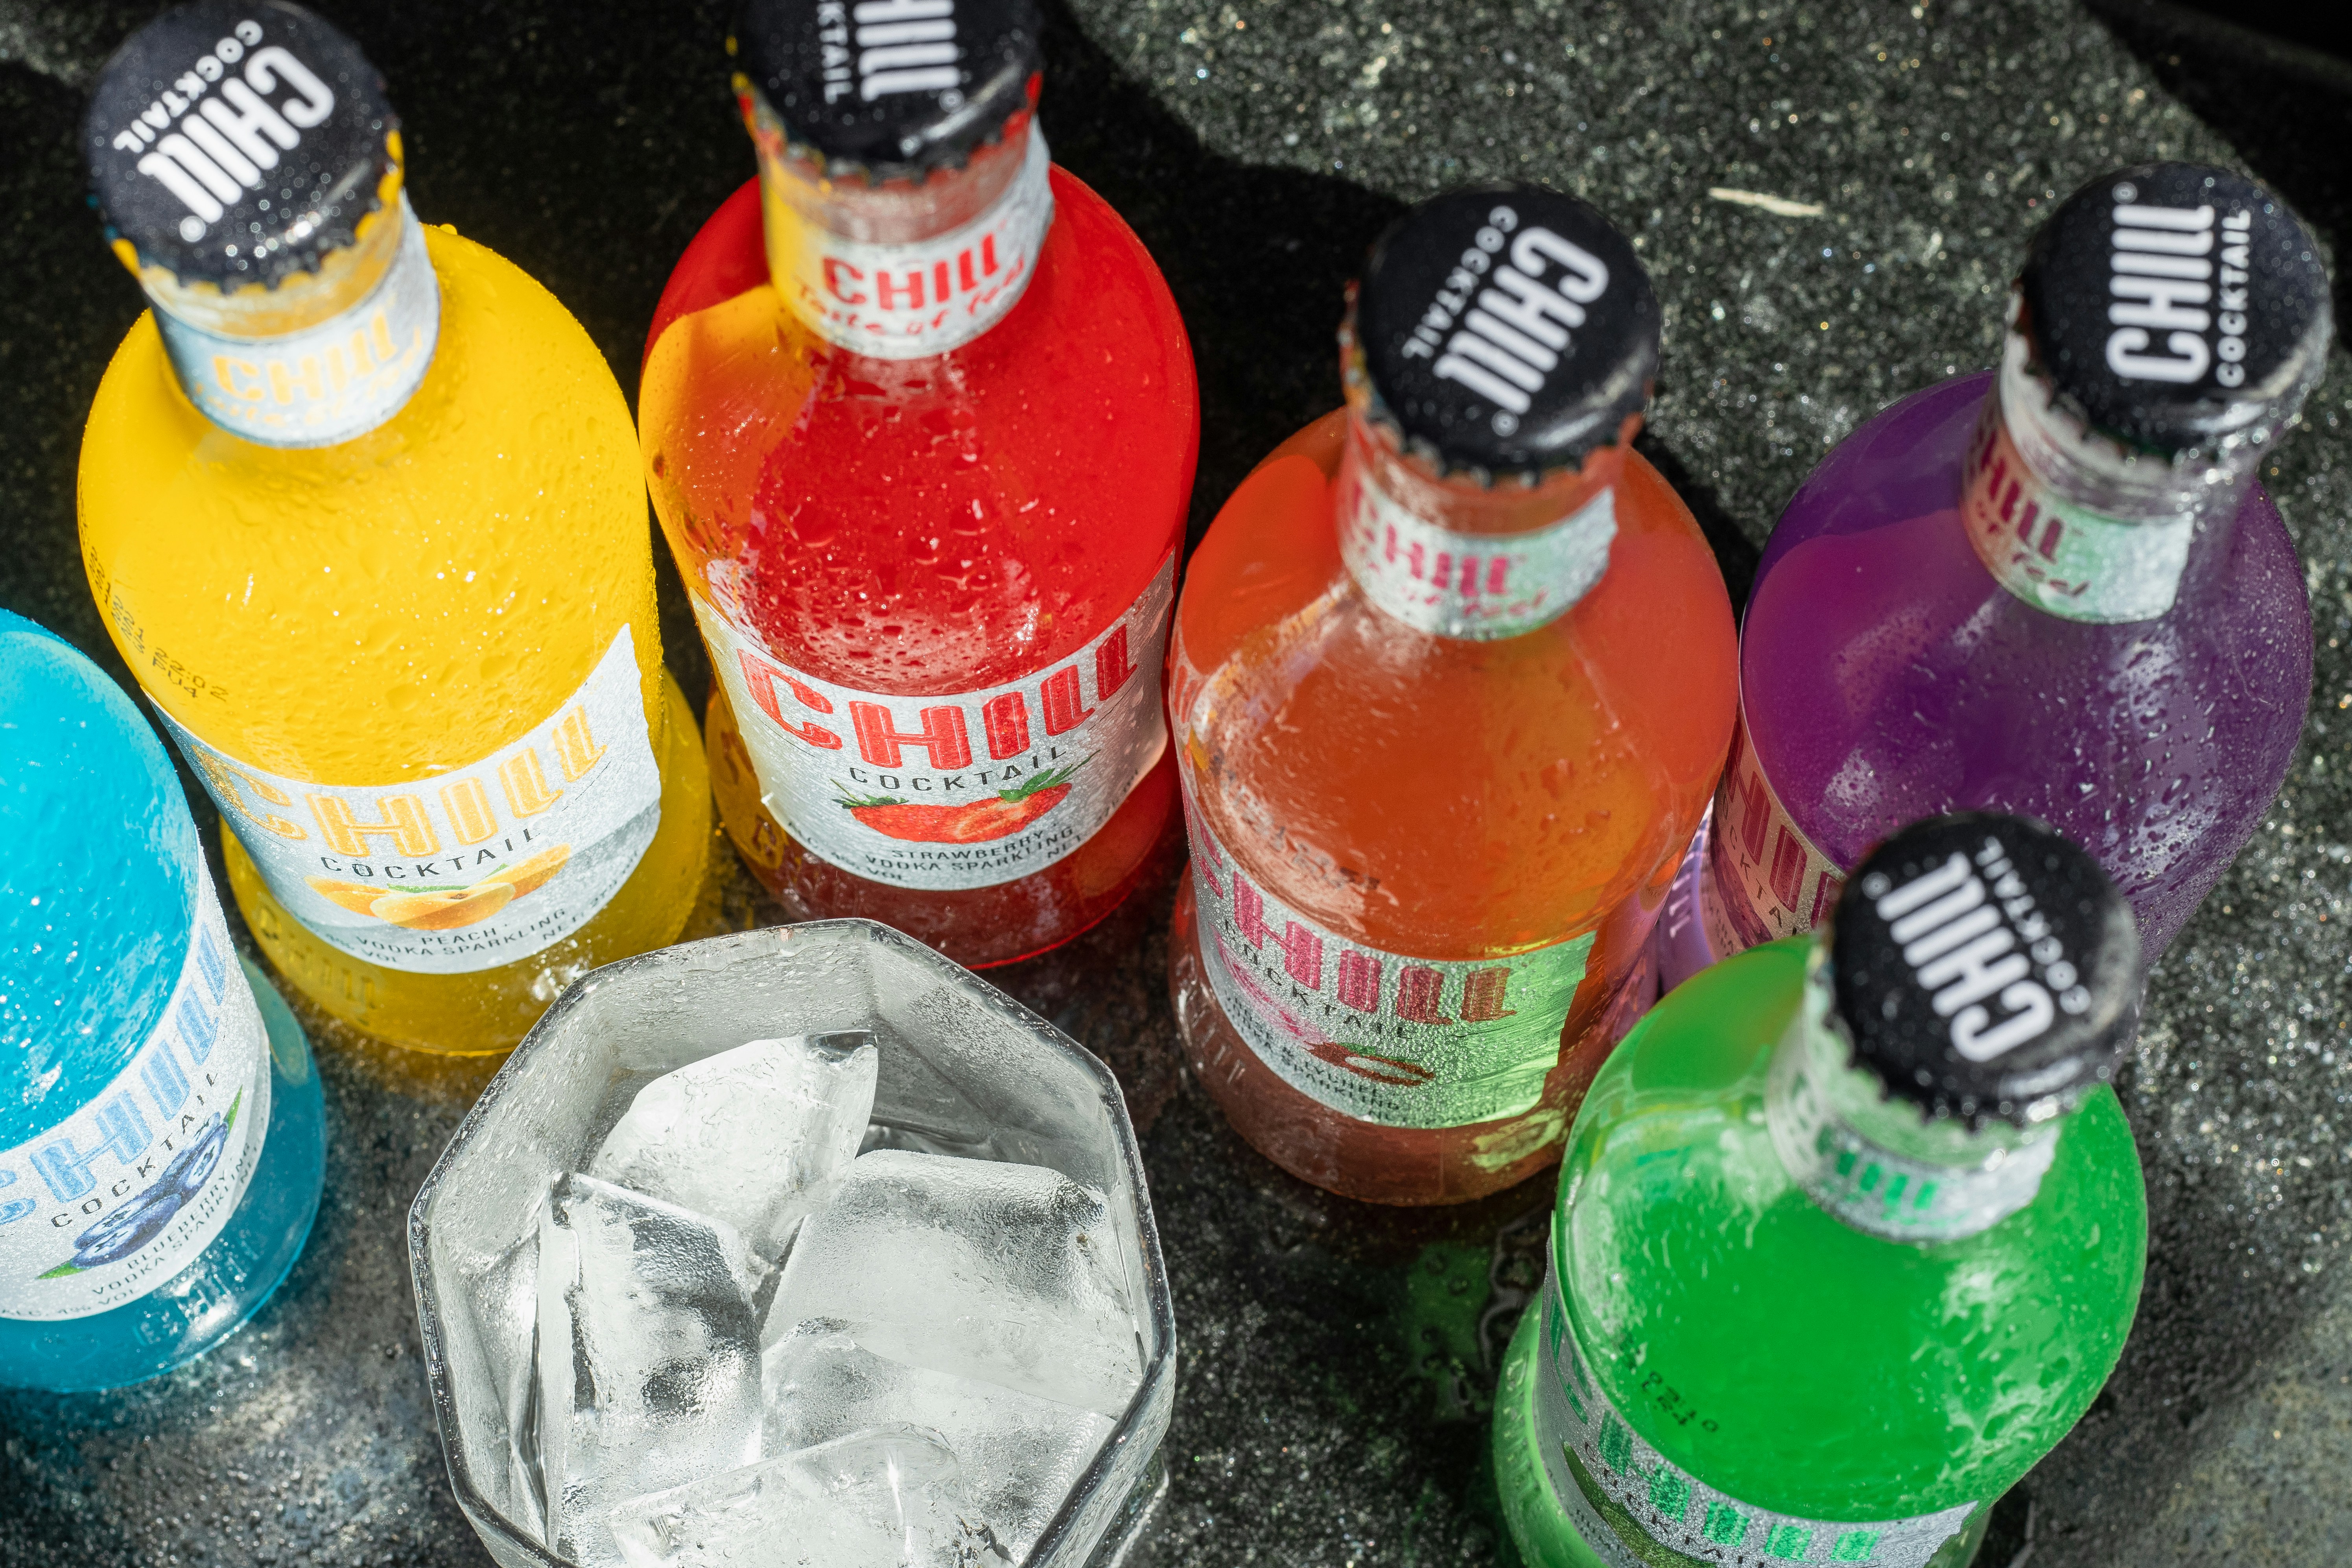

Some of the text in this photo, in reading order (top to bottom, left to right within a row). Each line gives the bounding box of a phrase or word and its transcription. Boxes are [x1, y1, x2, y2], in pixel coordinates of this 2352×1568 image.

[113, 19, 264, 153] COCKTAIL
[816, 0, 853, 105] KTAIL
[138, 46, 334, 223] CHILL
[822, 233, 1000, 311] CHILL
[1401, 205, 1519, 359] COCKTAIL
[1432, 226, 1609, 415] CHILL
[2105, 204, 2215, 383] CHILL
[2216, 209, 2251, 388] COCKTAIL
[212, 306, 398, 405] CHILL
[737, 624, 1137, 770] CHILL
[192, 705, 608, 857] CHILL
[849, 746, 1067, 792] COCKTAIL
[320, 827, 541, 879] COCKTAIL
[865, 826, 1074, 871] VODKA SPARKLING
[892, 830, 1044, 860] STRAWBERRY
[1181, 777, 1517, 1024] CHILL
[356, 908, 566, 956] VODKA SPARKLING
[422, 927, 496, 945] PEACH
[1225, 919, 1412, 1039] COCKTAIL
[1876, 851, 2055, 1061] CHILL
[1975, 835, 2091, 1015] COCKTAIL
[51, 1072, 218, 1227] COCKTAIL
[92, 1142, 250, 1295] VODKA SPARKLING
[127, 1169, 226, 1270] BLUEBERRY
